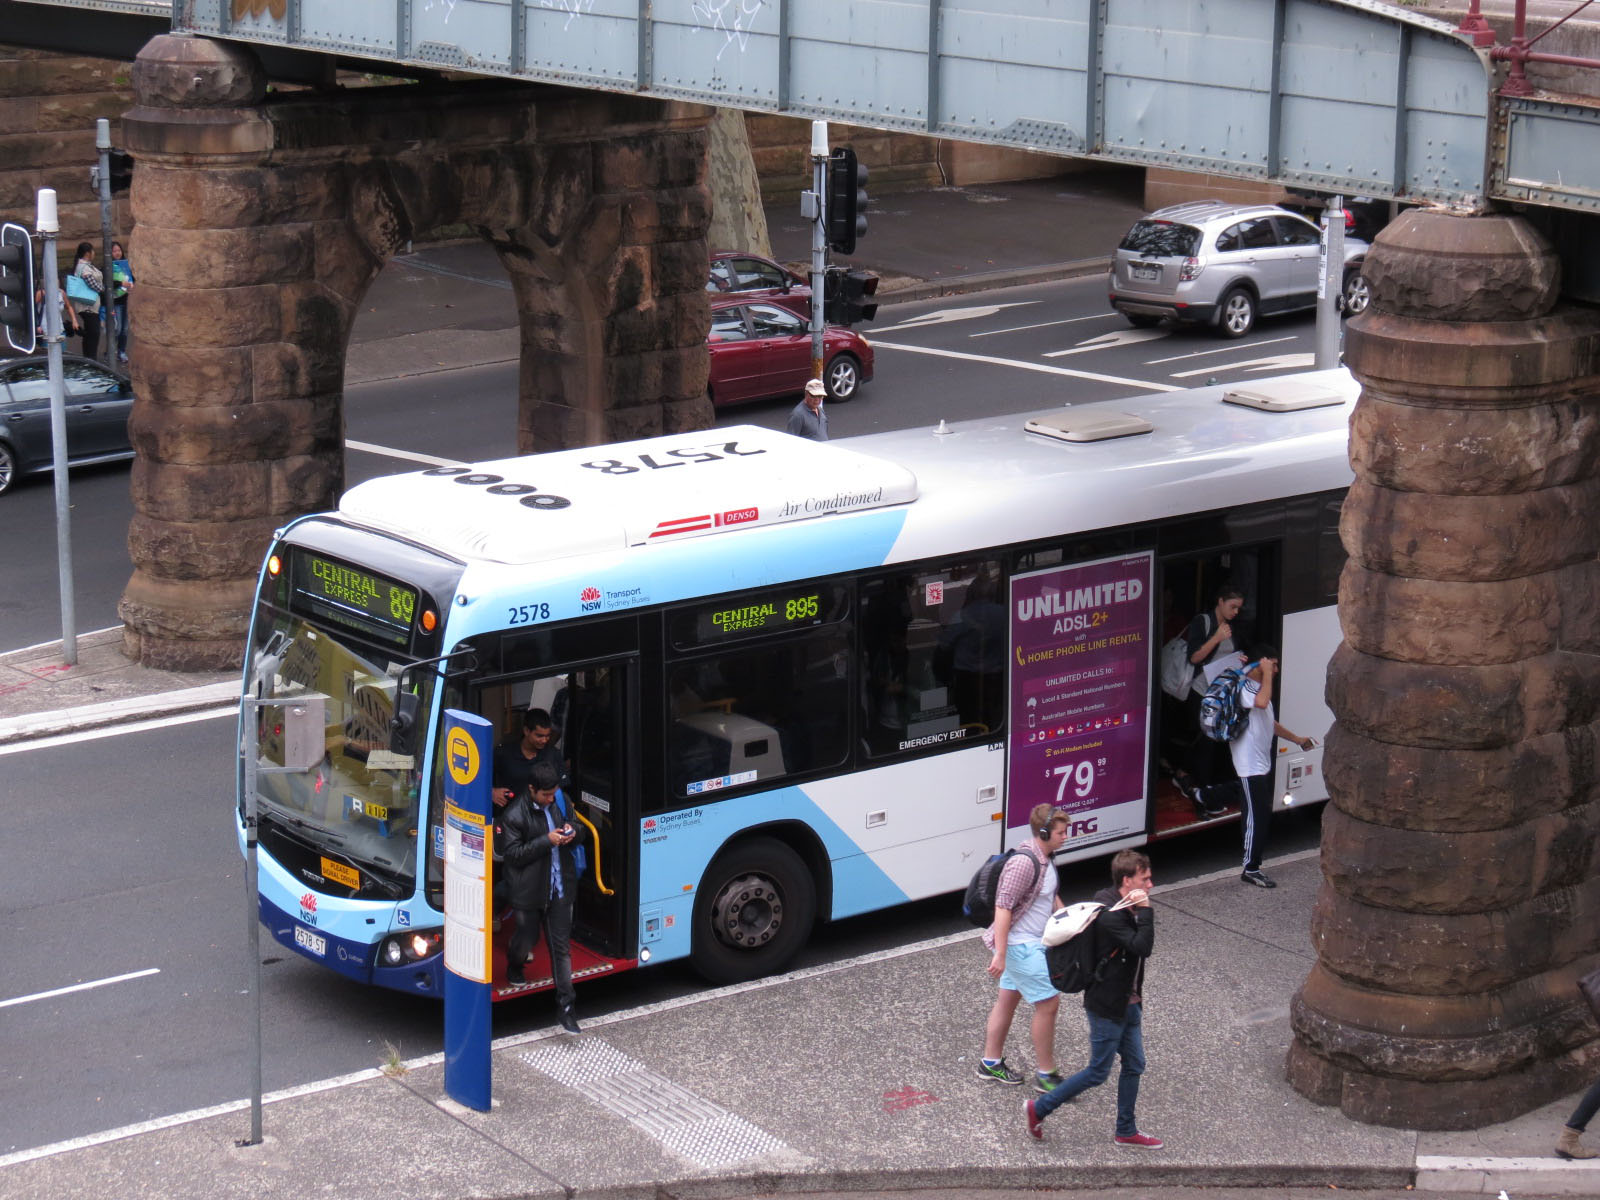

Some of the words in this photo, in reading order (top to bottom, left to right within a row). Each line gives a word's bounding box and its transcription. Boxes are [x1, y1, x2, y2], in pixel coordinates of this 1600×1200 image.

[778, 500, 801, 517] Air
[805, 487, 882, 511] Conditioned
[726, 509, 756, 522] DENSO
[311, 559, 382, 599] CENTRAL
[324, 581, 369, 607] EXPRESS
[606, 587, 641, 600] Transport
[1017, 578, 1143, 622] UNLIMITED
[508, 602, 551, 625] 2578
[581, 601, 602, 613] NSW
[606, 599, 630, 610] Sydney
[712, 603, 778, 625] CENTRAL
[785, 594, 819, 620] 895
[723, 616, 766, 632] EXPRESS
[1053, 611, 1109, 635] ADSL2+
[1027, 650, 1054, 664] HOME
[1056, 643, 1086, 657] PHONE
[1087, 637, 1107, 651] LINE
[1109, 632, 1142, 646] RENTAL
[1074, 633, 1087, 642] with
[1045, 673, 1082, 687] UNLIMITED
[1082, 668, 1105, 679] CALLS
[1105, 666, 1114, 675] to:
[1060, 689, 1083, 700] Standard
[1083, 684, 1104, 695] National
[899, 732, 949, 750] EMERGENCY
[949, 728, 967, 740] EXIT
[1045, 769, 1050, 778] $
[1053, 760, 1094, 802] 79
[1097, 757, 1107, 767] 99
[660, 809, 693, 824] Operated
[694, 809, 703, 817] By
[1066, 817, 1098, 838] PG
[330, 862, 350, 875] PLEASE
[300, 909, 317, 926] NSW
[296, 928, 313, 947] 2578
[315, 937, 325, 954] ST
